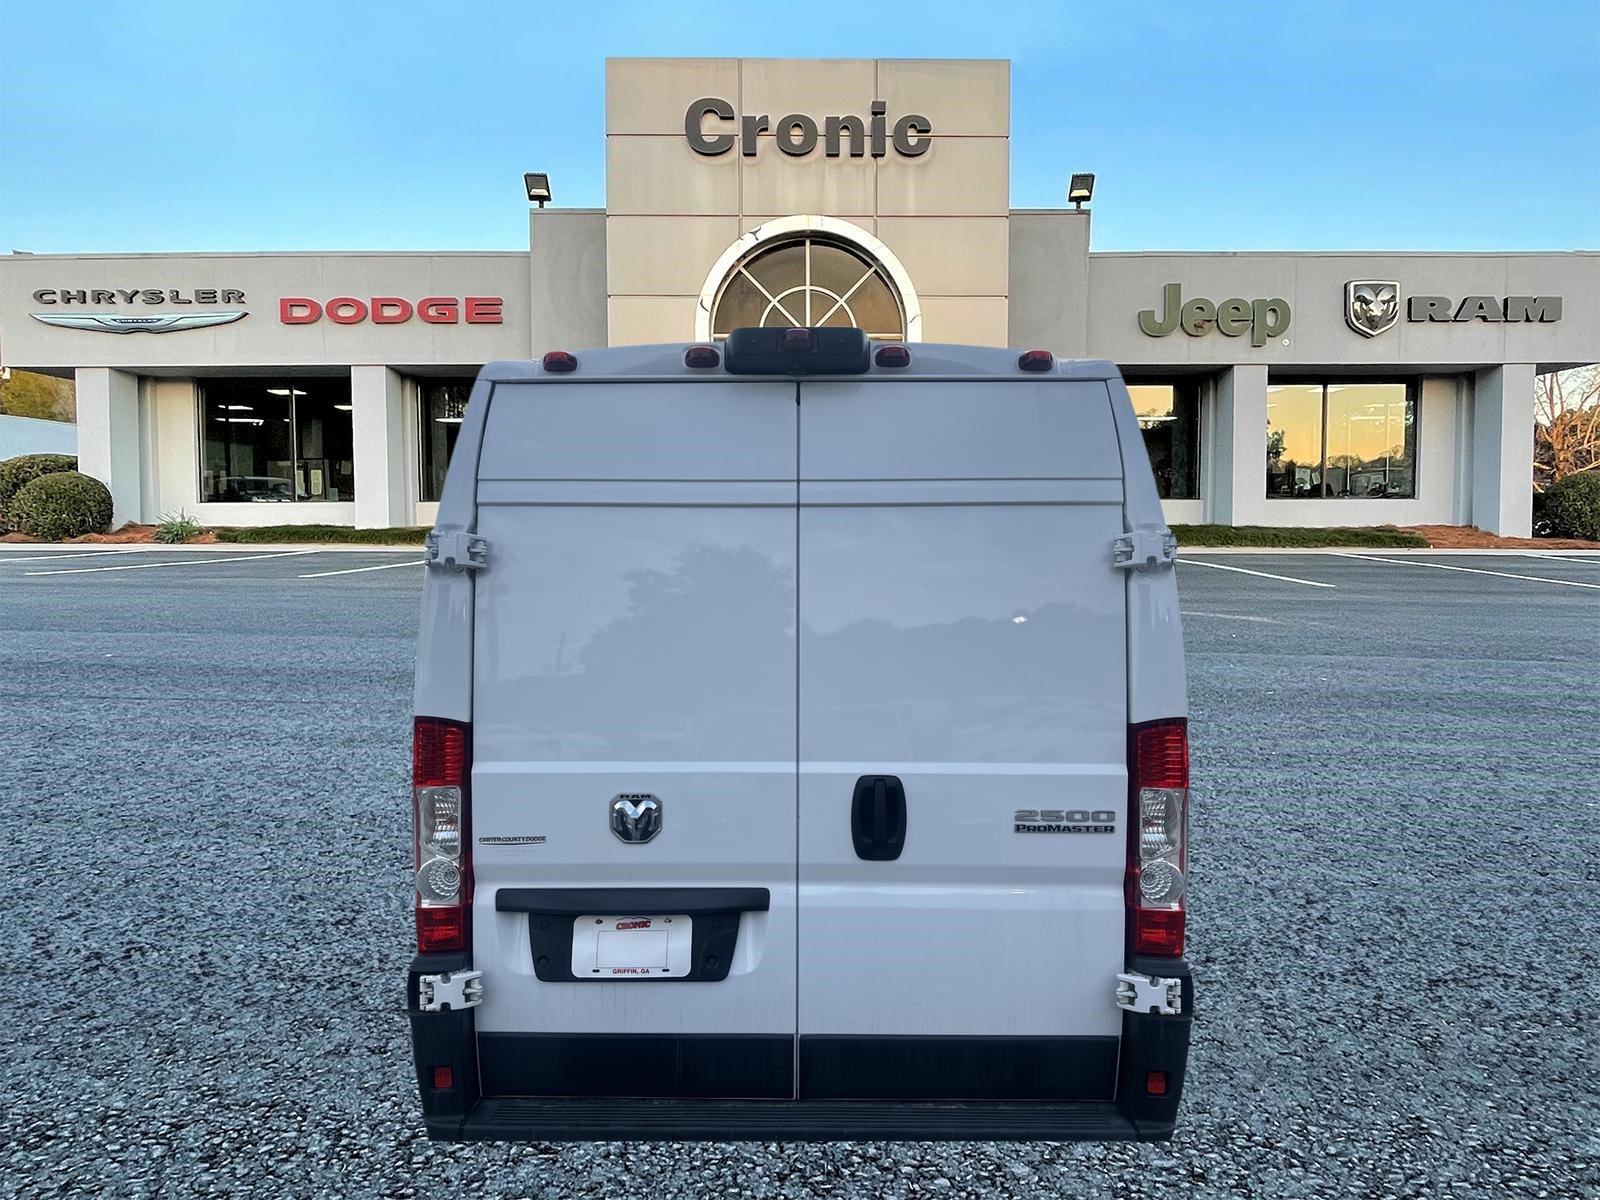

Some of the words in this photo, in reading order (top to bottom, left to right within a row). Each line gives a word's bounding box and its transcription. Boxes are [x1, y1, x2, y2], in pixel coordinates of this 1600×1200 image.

[685, 97, 932, 158] Cronic
[32, 289, 246, 305] CHRYSLER
[1407, 296, 1563, 323] RAM
[280, 297, 504, 325] DODGE
[1138, 283, 1291, 347] Jeep
[1014, 809, 1116, 823] 2500
